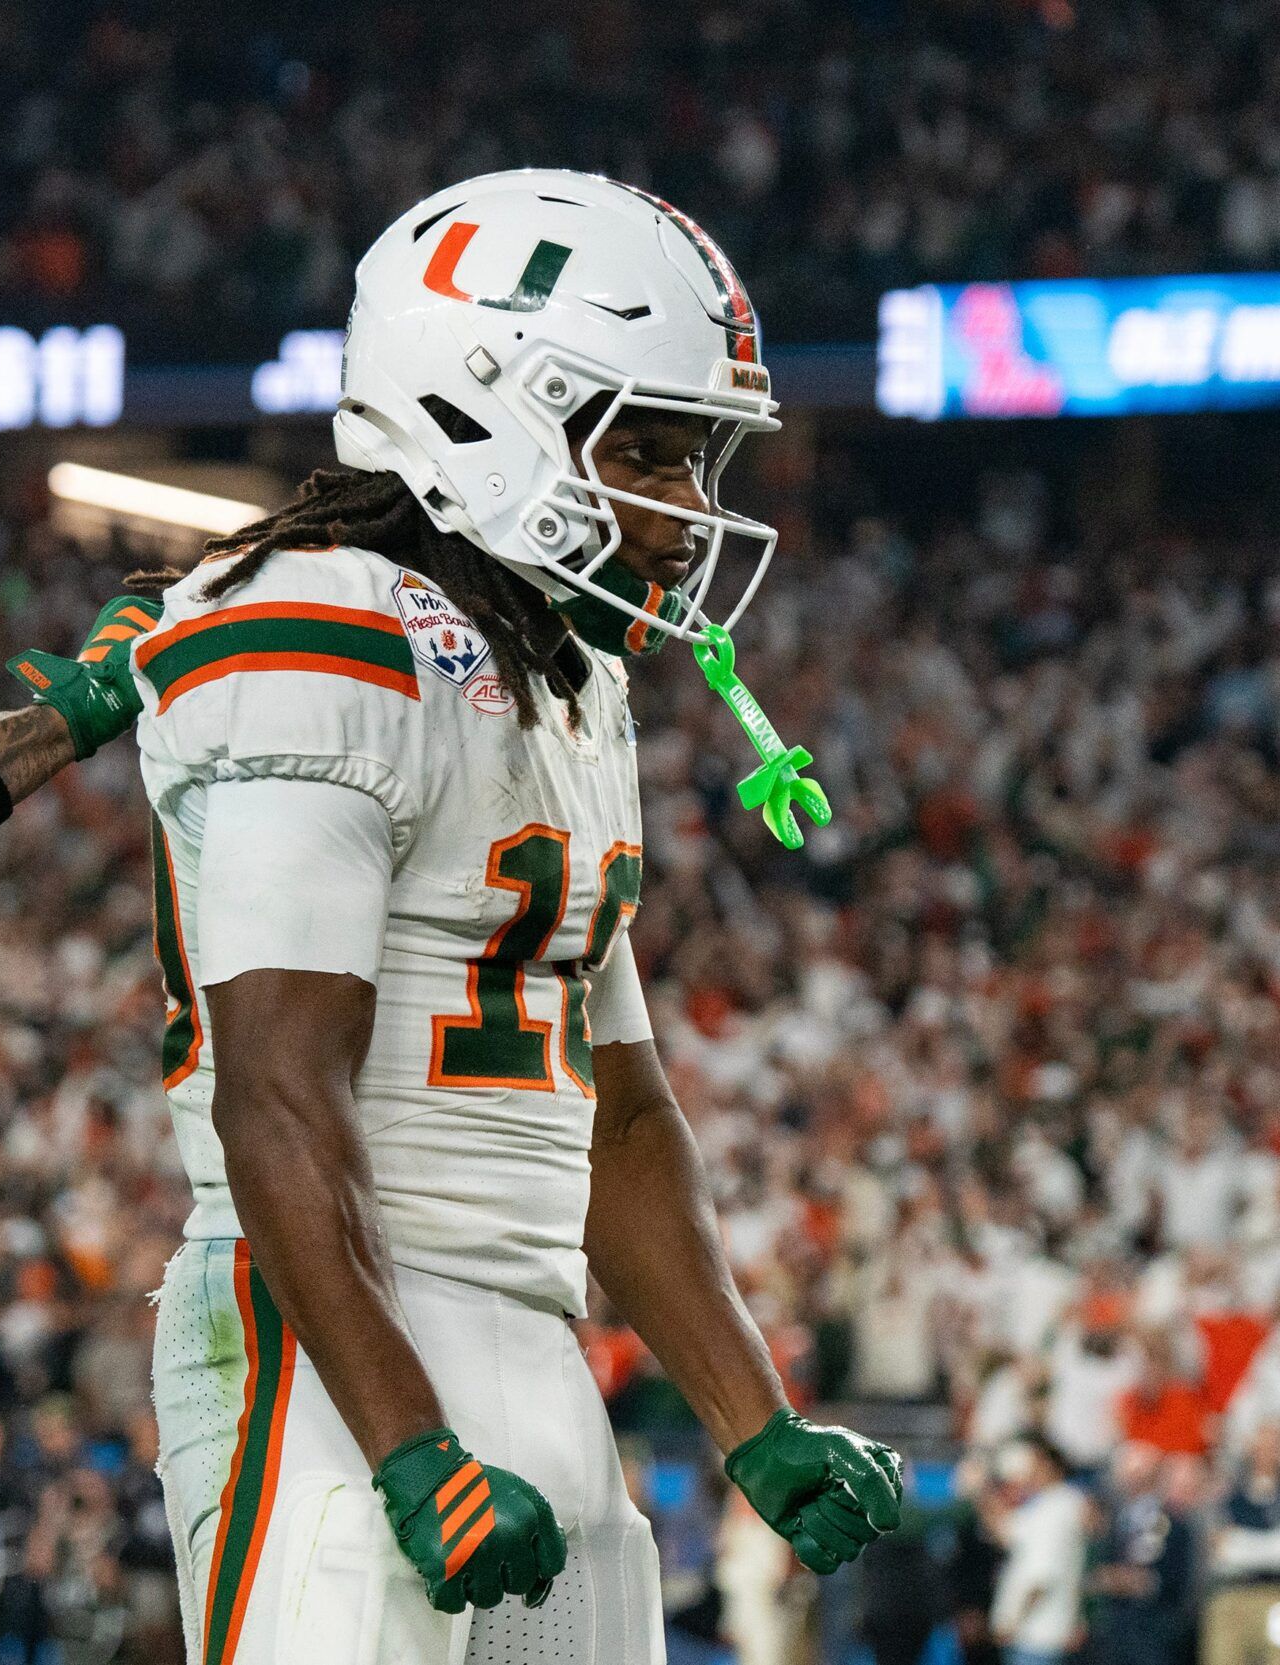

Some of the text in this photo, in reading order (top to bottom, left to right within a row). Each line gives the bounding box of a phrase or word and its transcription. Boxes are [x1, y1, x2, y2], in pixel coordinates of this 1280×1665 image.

[423, 222, 573, 313] U
[409, 593, 449, 611] Vrbo
[407, 613, 442, 634] Fiesta
[473, 684, 510, 700] ACC
[728, 684, 779, 754] NXTRND
